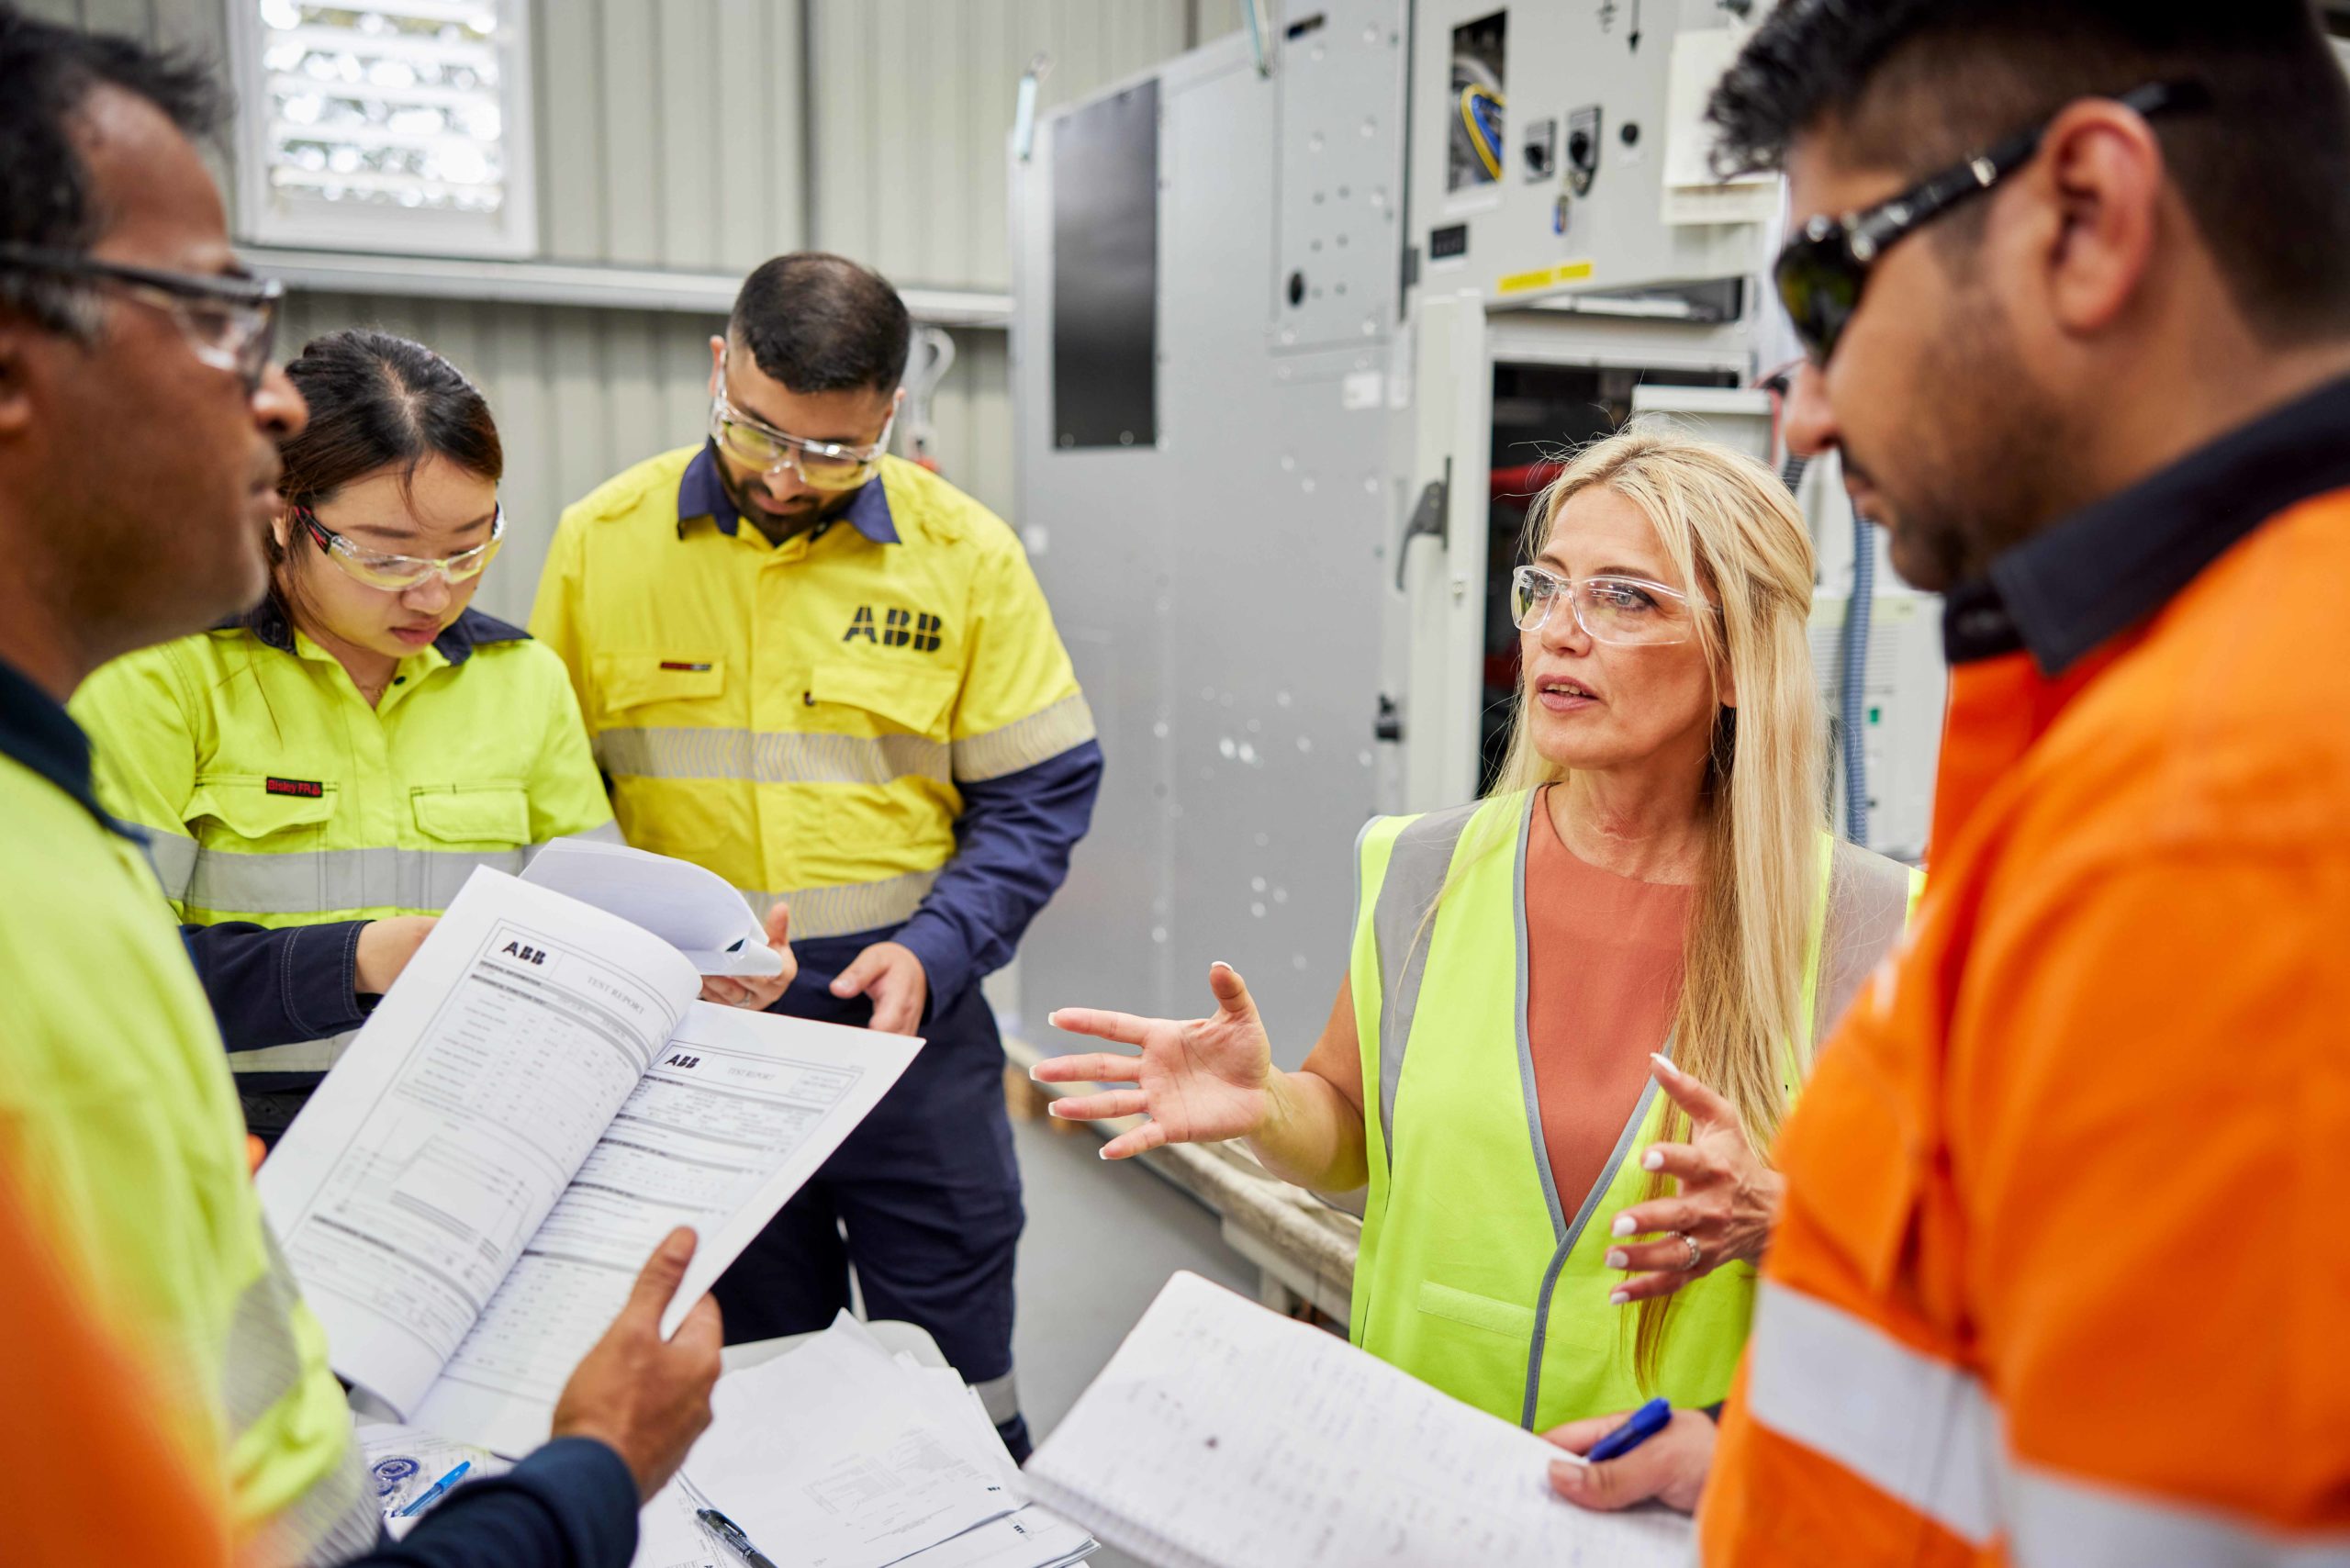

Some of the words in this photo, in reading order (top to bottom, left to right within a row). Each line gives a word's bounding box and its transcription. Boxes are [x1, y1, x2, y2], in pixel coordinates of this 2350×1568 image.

[843, 606, 942, 653] ABB
[501, 941, 546, 965] ABB
[588, 976, 610, 992] TEST
[610, 989, 644, 1014] REPORT
[665, 1054, 700, 1069] ABB
